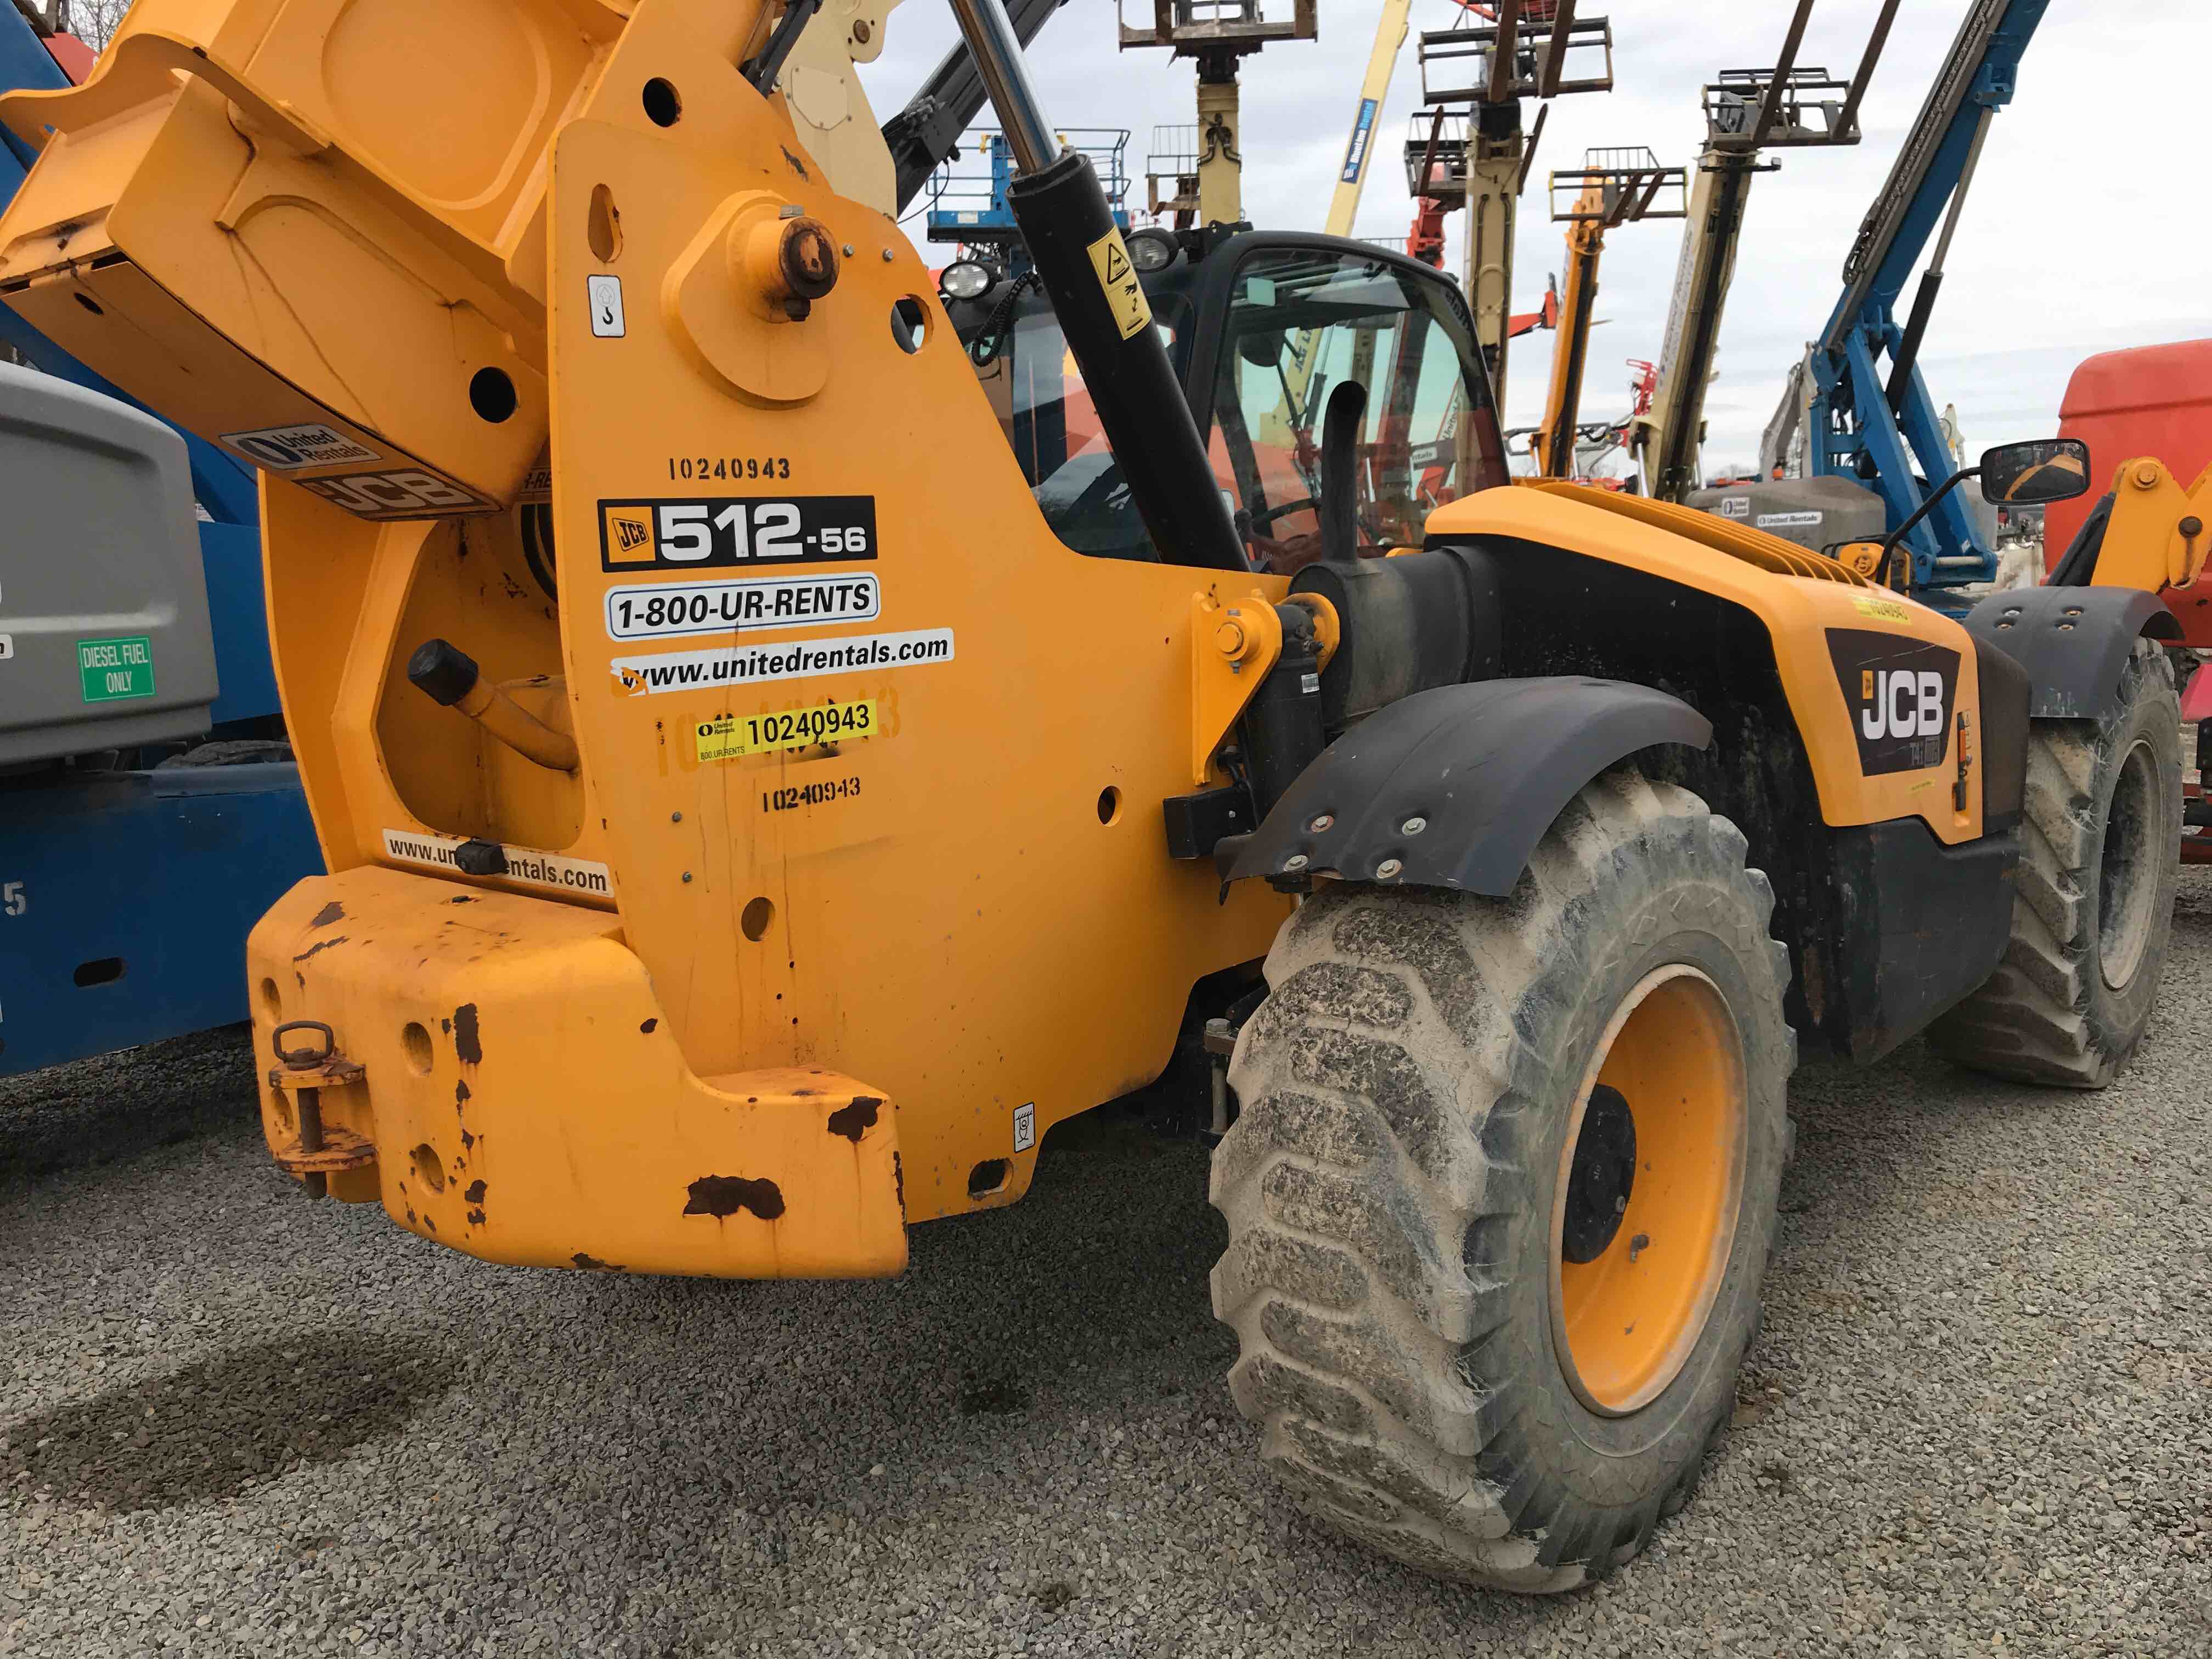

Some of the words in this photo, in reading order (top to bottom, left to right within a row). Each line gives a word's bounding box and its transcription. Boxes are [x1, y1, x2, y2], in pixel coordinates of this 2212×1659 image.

[275, 430, 338, 447] United
[299, 443, 371, 461] Rentals
[669, 457, 791, 481] 10240943
[311, 472, 476, 511] JCB
[1790, 515, 1818, 523] Rentals
[619, 521, 647, 549] JCB
[618, 583, 870, 629] 1-800-UR-RENTS
[83, 646, 121, 668] DIESEL
[122, 644, 149, 665] FUEL
[106, 671, 132, 693] ONLY
[1863, 670, 1944, 740] JCB
[714, 721, 733, 729] United
[714, 727, 735, 735] Rentals
[748, 704, 870, 745] 10240943
[700, 746, 745, 760] 800.UR.RENTS
[763, 777, 861, 812] 10240943
[389, 838, 607, 891] www.unentals.com
